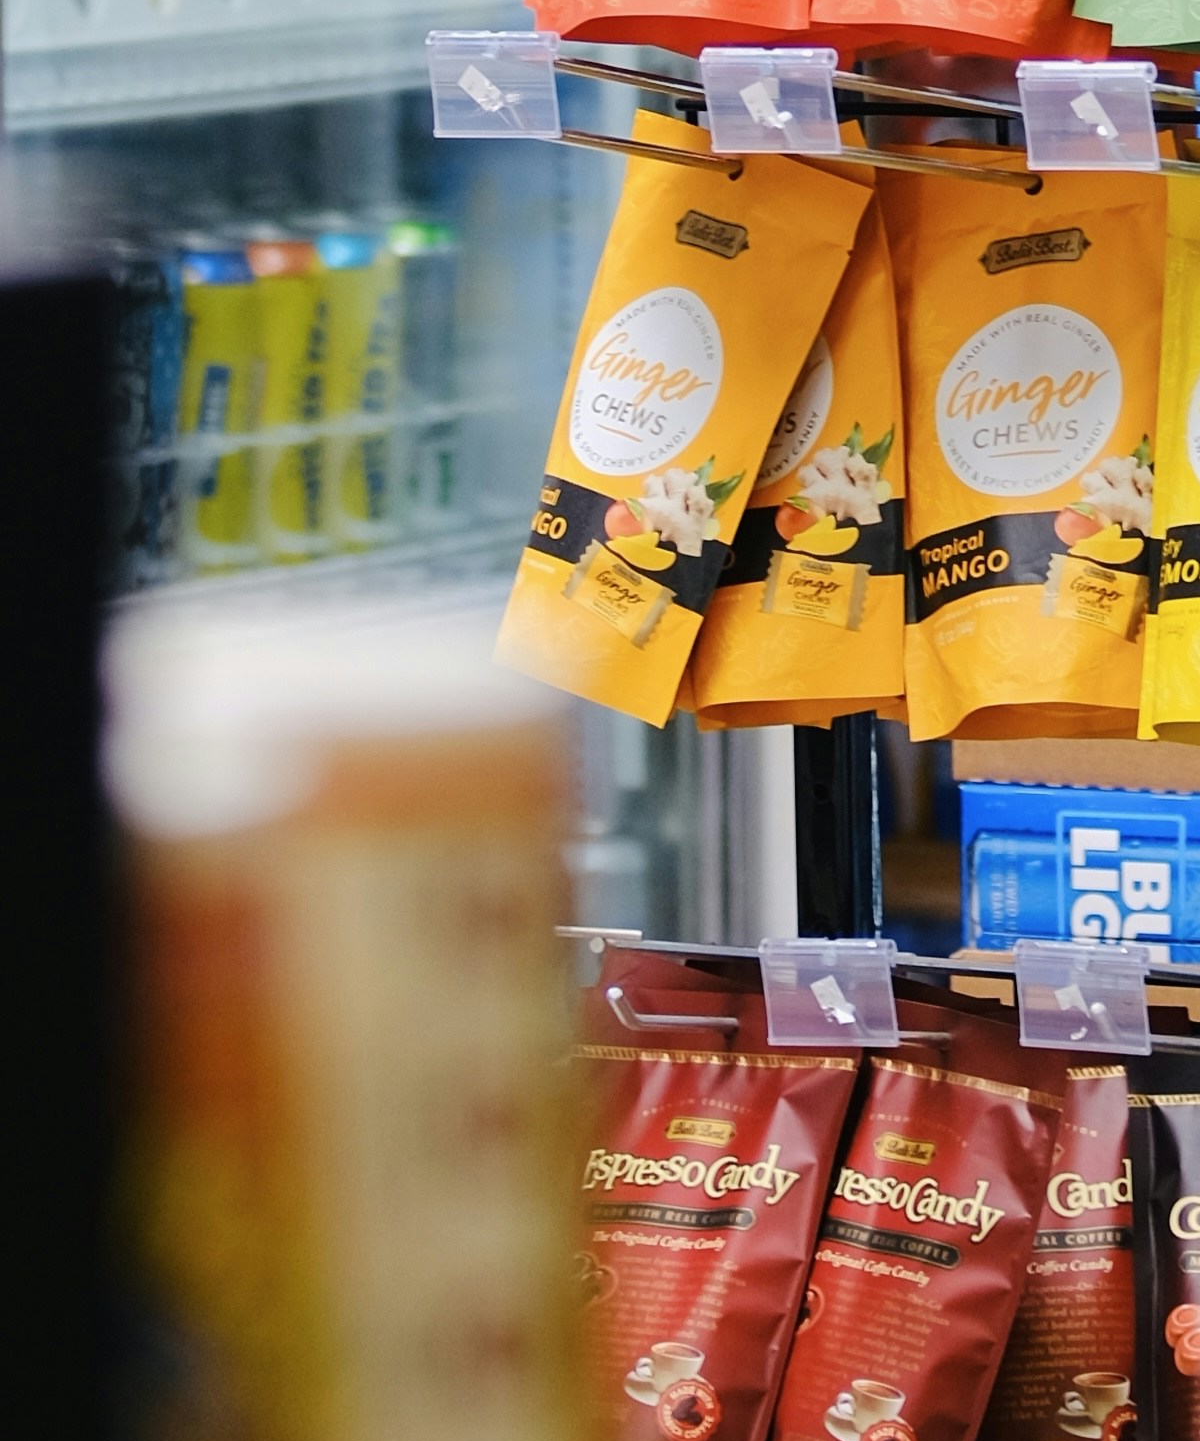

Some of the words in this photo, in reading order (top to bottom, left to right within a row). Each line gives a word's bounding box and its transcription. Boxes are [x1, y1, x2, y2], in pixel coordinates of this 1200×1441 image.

[957, 338, 987, 372] MADE
[989, 317, 1023, 339] WITH
[1025, 313, 1059, 326] REAL
[1062, 320, 1102, 355] GINGER
[588, 331, 713, 405] Ginger
[591, 393, 668, 437] CHEWS
[945, 369, 1112, 426] Ginger
[648, 424, 689, 461] CANDY
[793, 410, 820, 457] CANDY
[972, 419, 1080, 448] CHEWS
[982, 475, 1018, 490] SPICY
[1023, 464, 1072, 488] CHEWY
[1074, 419, 1106, 463] CANDY
[920, 530, 985, 566] Tropical
[922, 549, 1010, 599] MANGO
[1069, 827, 1122, 946] LIG
[1121, 860, 1172, 964] BU
[1047, 1158, 1133, 1219] Cand
[593, 1231, 611, 1243] The
[611, 1231, 660, 1248] Original
[660, 1236, 695, 1251] Coffee
[694, 1236, 727, 1252] Candy
[901, 1238, 950, 1262] COFFEE
[1065, 1231, 1123, 1246] COFFEE
[822, 1250, 864, 1272] Original
[892, 1264, 931, 1286] Candy
[1027, 1260, 1069, 1276] Coffee
[1070, 1257, 1114, 1273] Candy
